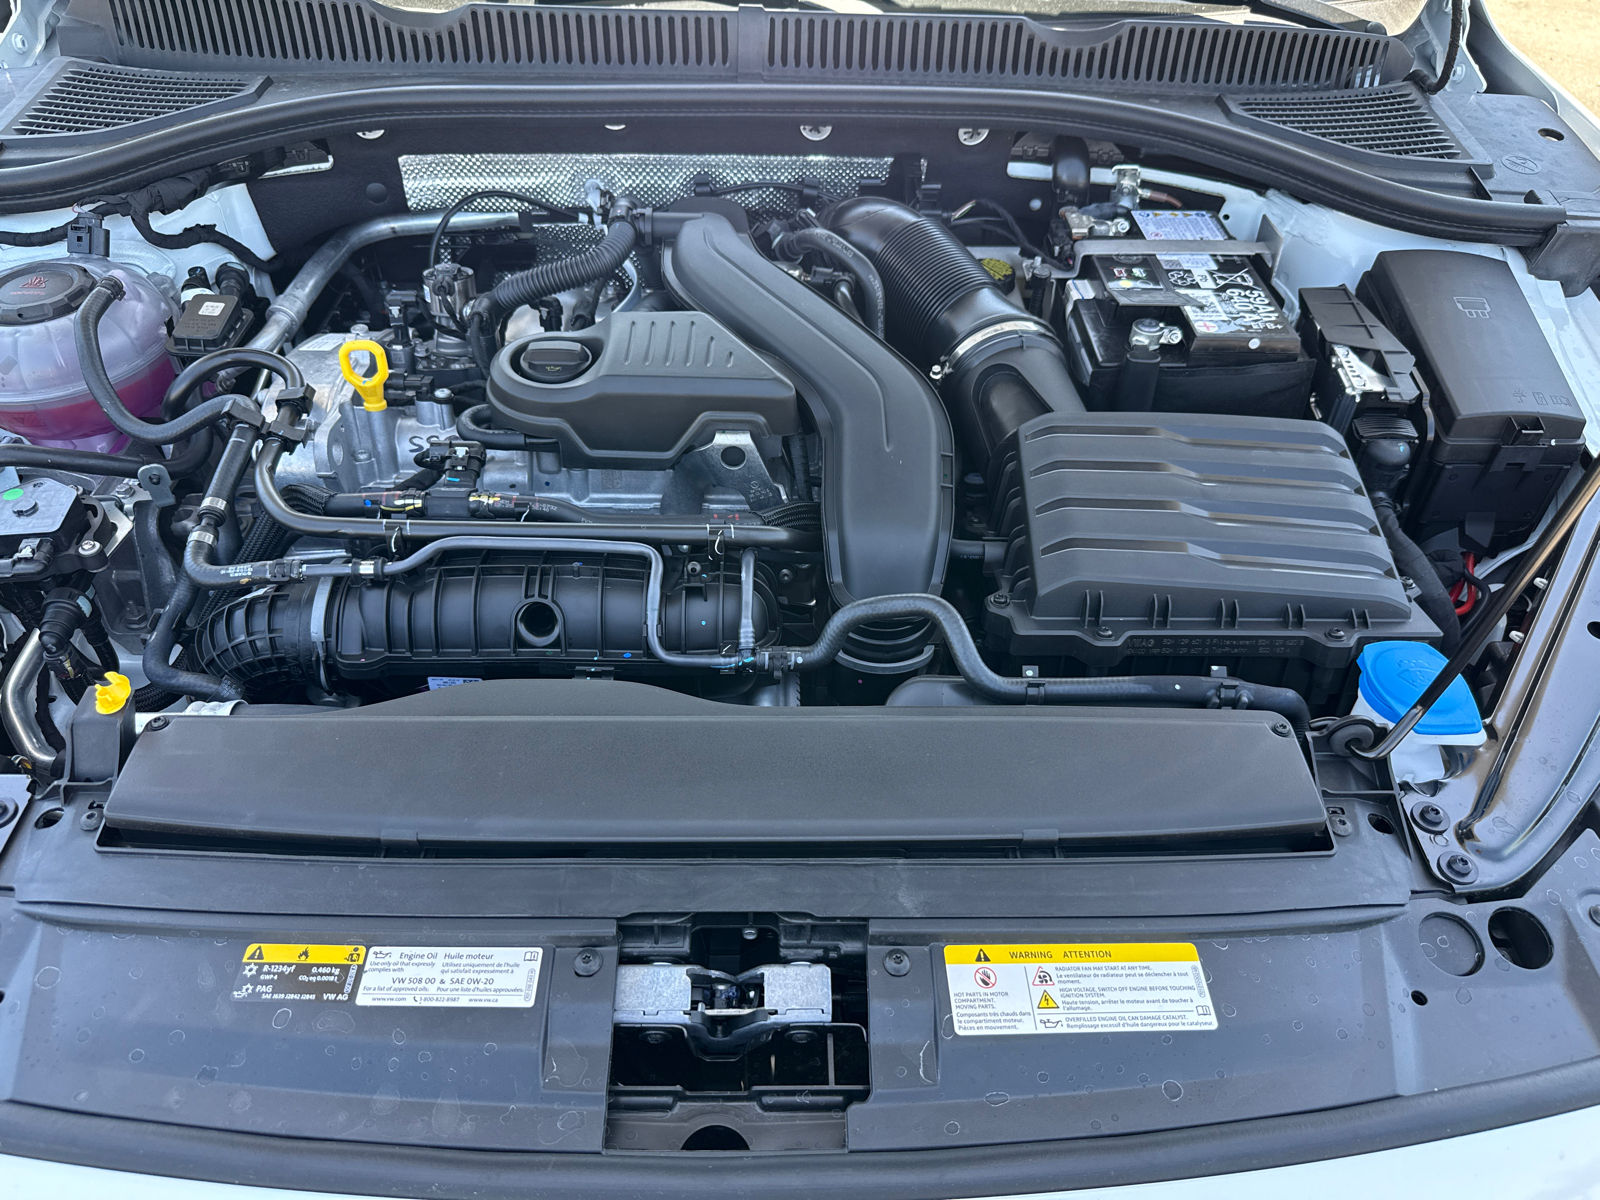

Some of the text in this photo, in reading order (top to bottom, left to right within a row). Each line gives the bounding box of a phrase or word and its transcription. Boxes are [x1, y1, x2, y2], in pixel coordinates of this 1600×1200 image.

[1226, 289, 1261, 322] 640 A
[1246, 290, 1279, 321] 59Ah
[400, 952, 425, 960] Engine
[262, 965, 296, 974] R-1234yf
